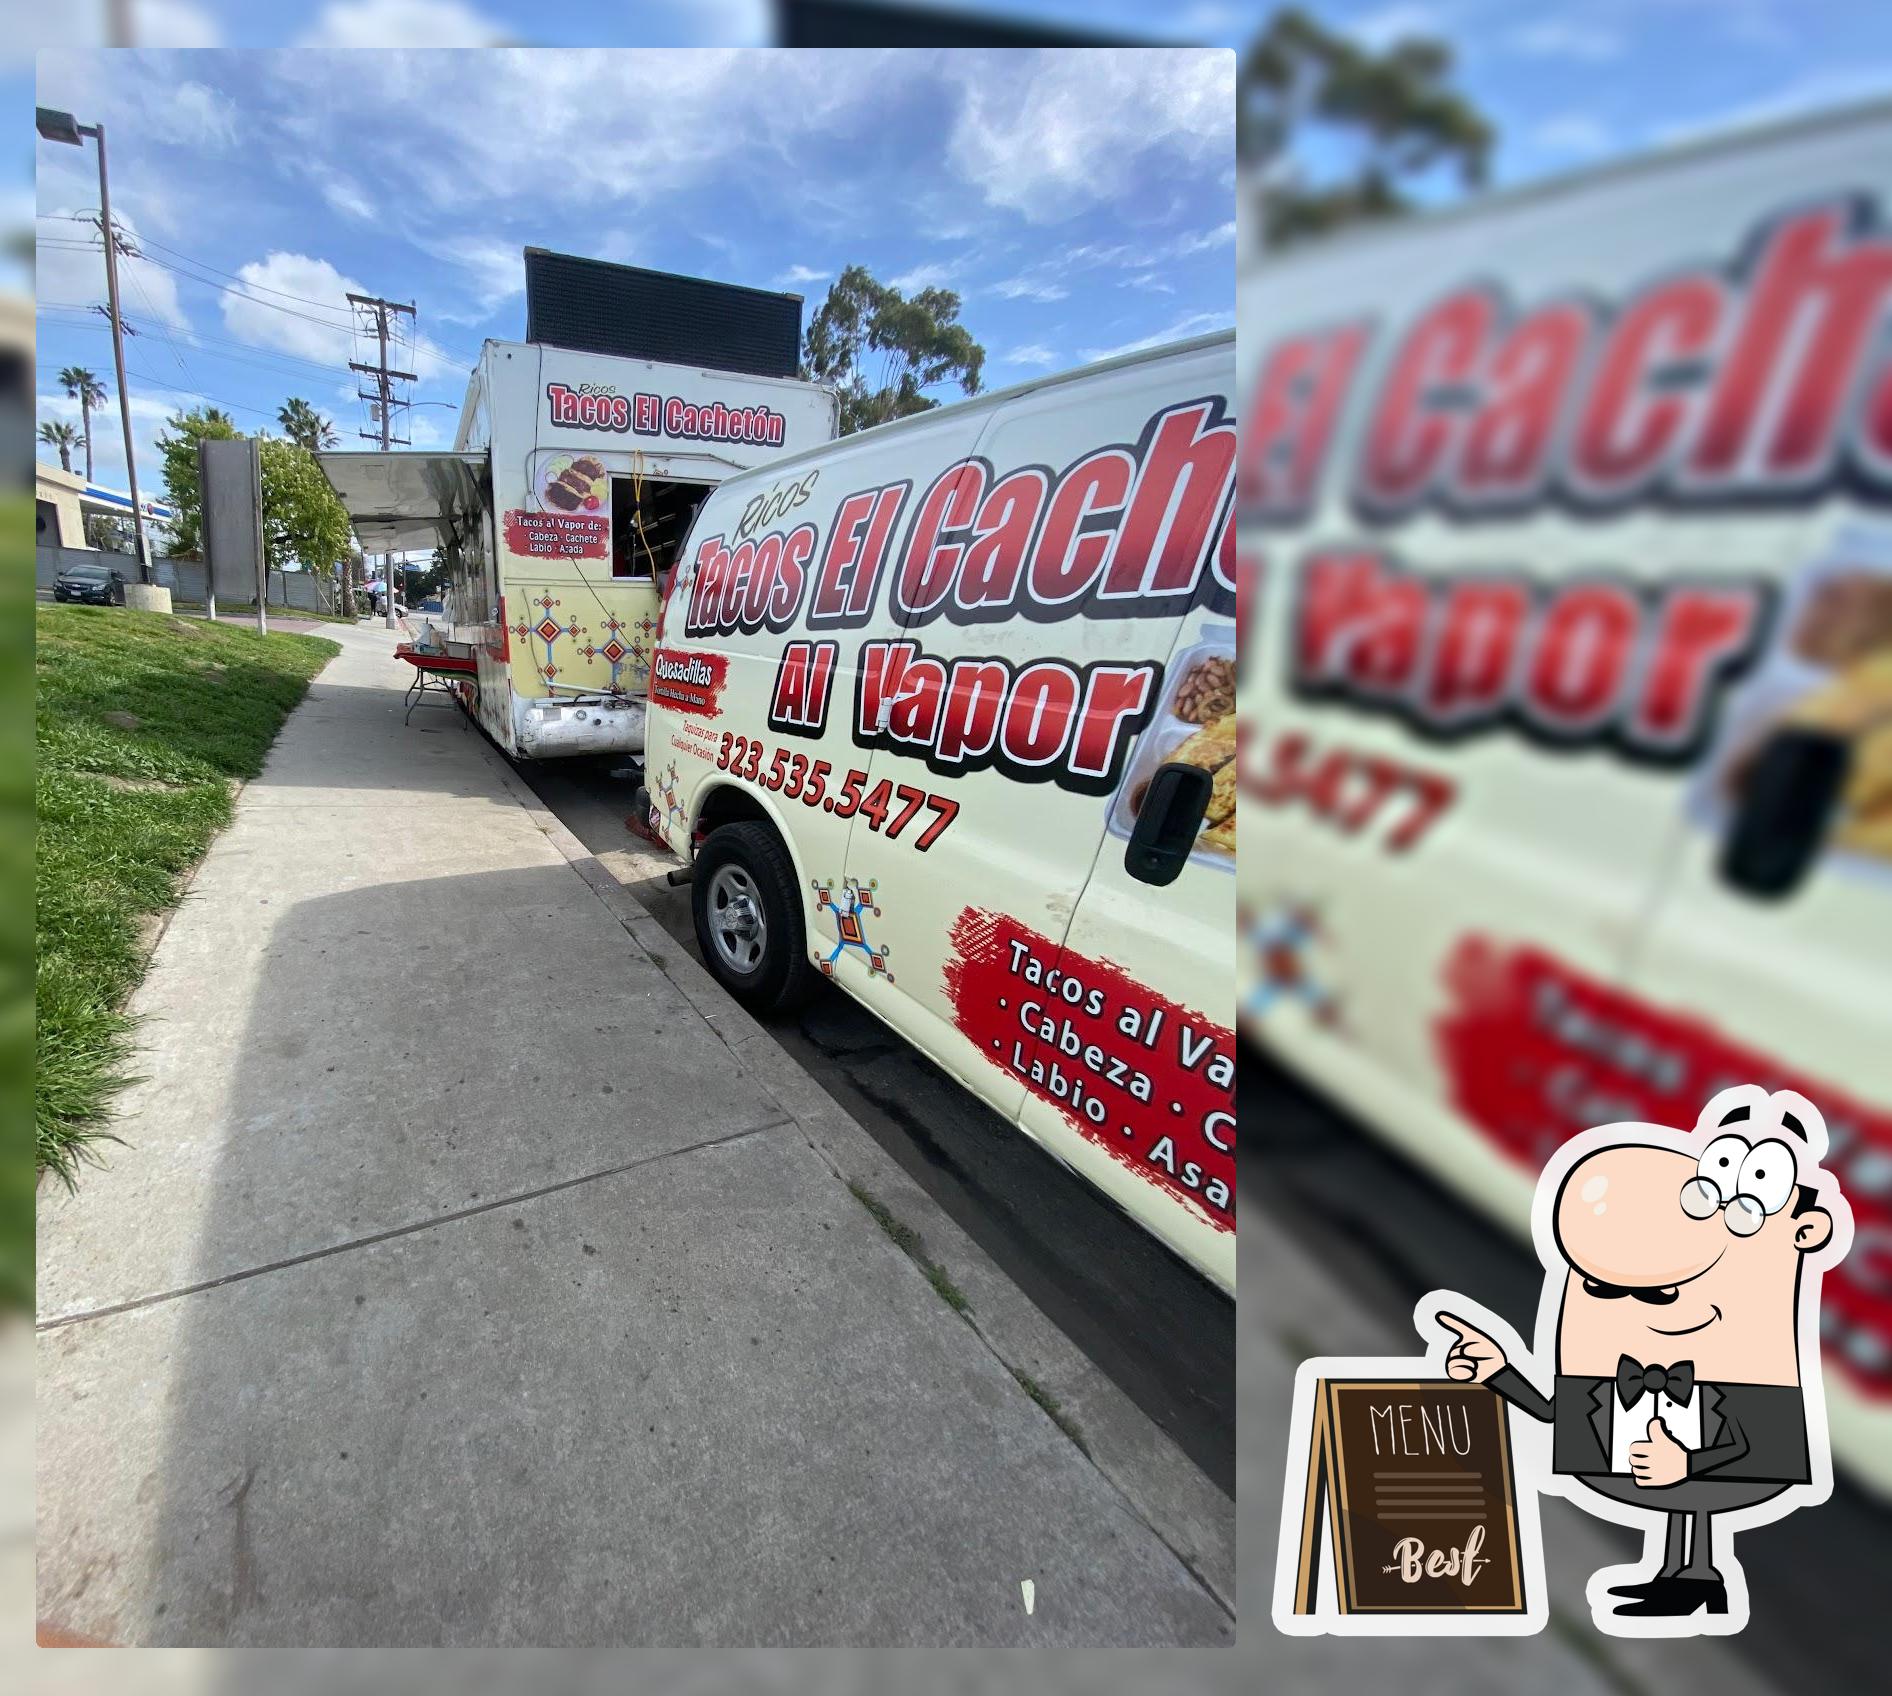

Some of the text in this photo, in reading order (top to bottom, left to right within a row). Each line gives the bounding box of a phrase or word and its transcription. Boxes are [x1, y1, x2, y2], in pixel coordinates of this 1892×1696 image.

[578, 383, 617, 395] Ricos
[1365, 208, 1892, 497] Cach
[549, 384, 783, 443] Tacos El Cachetón
[517, 516, 602, 531] Tacos al Vapor de:
[529, 531, 598, 544] Cabeza Cachete
[733, 470, 820, 543] Ricos
[530, 543, 552, 553] Labio
[687, 526, 815, 631] Tacos
[812, 486, 907, 620] El
[655, 653, 713, 686] Quesadillas
[683, 720, 719, 743] Taquizas para
[771, 643, 1154, 778] Al Vapor
[716, 731, 960, 853] 323.535.5477
[1009, 939, 1106, 1017] Tacos
[1117, 1005, 1163, 1048] al
[1013, 1040, 1107, 1124] Labio
[1019, 1001, 1152, 1102] Cabeza
